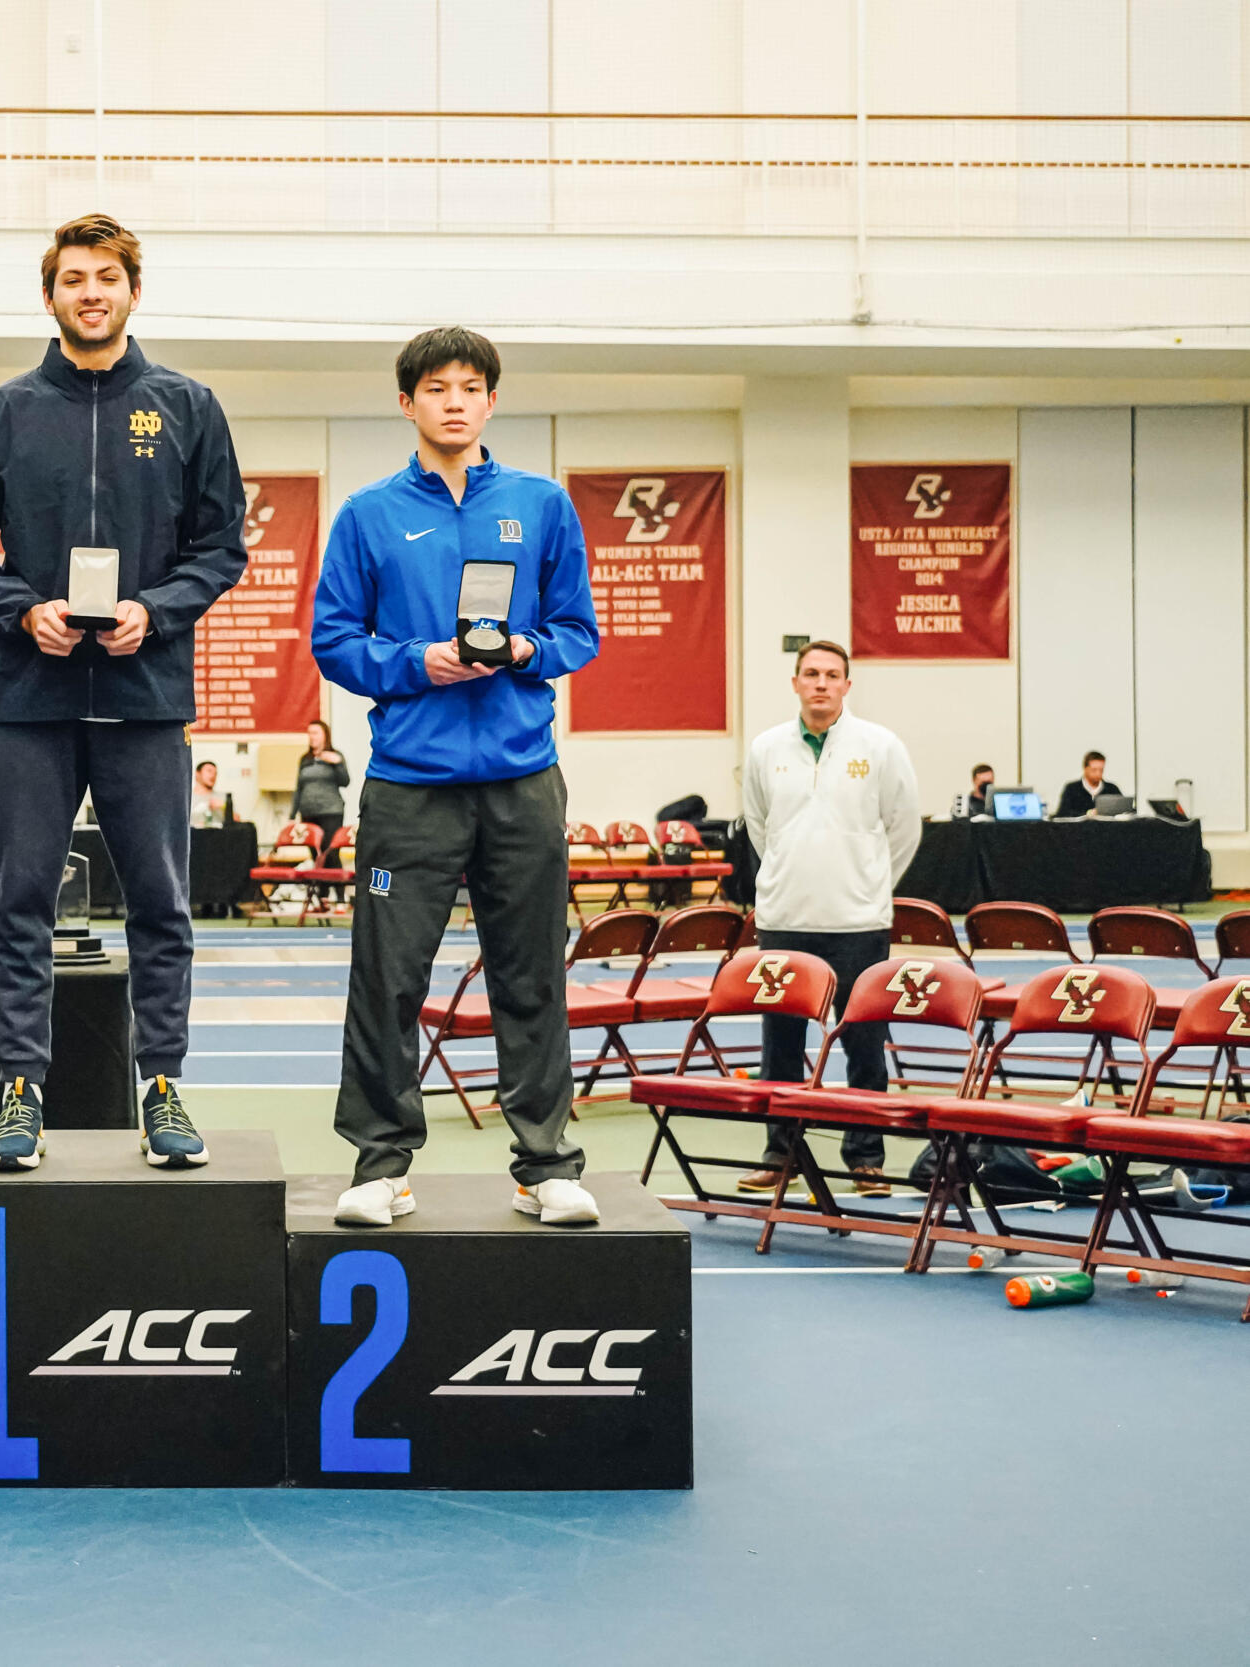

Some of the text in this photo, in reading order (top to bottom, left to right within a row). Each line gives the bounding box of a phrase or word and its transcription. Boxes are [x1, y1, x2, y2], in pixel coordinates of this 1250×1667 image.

[129, 409, 162, 437] ND
[497, 519, 522, 538] D
[859, 527, 892, 541] USTA
[903, 527, 925, 540] ITA
[927, 526, 999, 540] NORTHEAST
[594, 545, 701, 560] WOMEN'S TENNIS
[875, 541, 984, 556] REGIONAL SINGLES
[591, 563, 704, 582] ALL-ACC TEAM
[898, 557, 960, 571] CHAMPION
[252, 568, 298, 586] TEAM
[896, 595, 962, 613] JESSICA
[895, 615, 963, 633] WACNIK
[370, 867, 391, 892] D
[46, 1309, 252, 1361] ACC
[320, 1250, 411, 1473] 2
[448, 1329, 657, 1381] ACC
